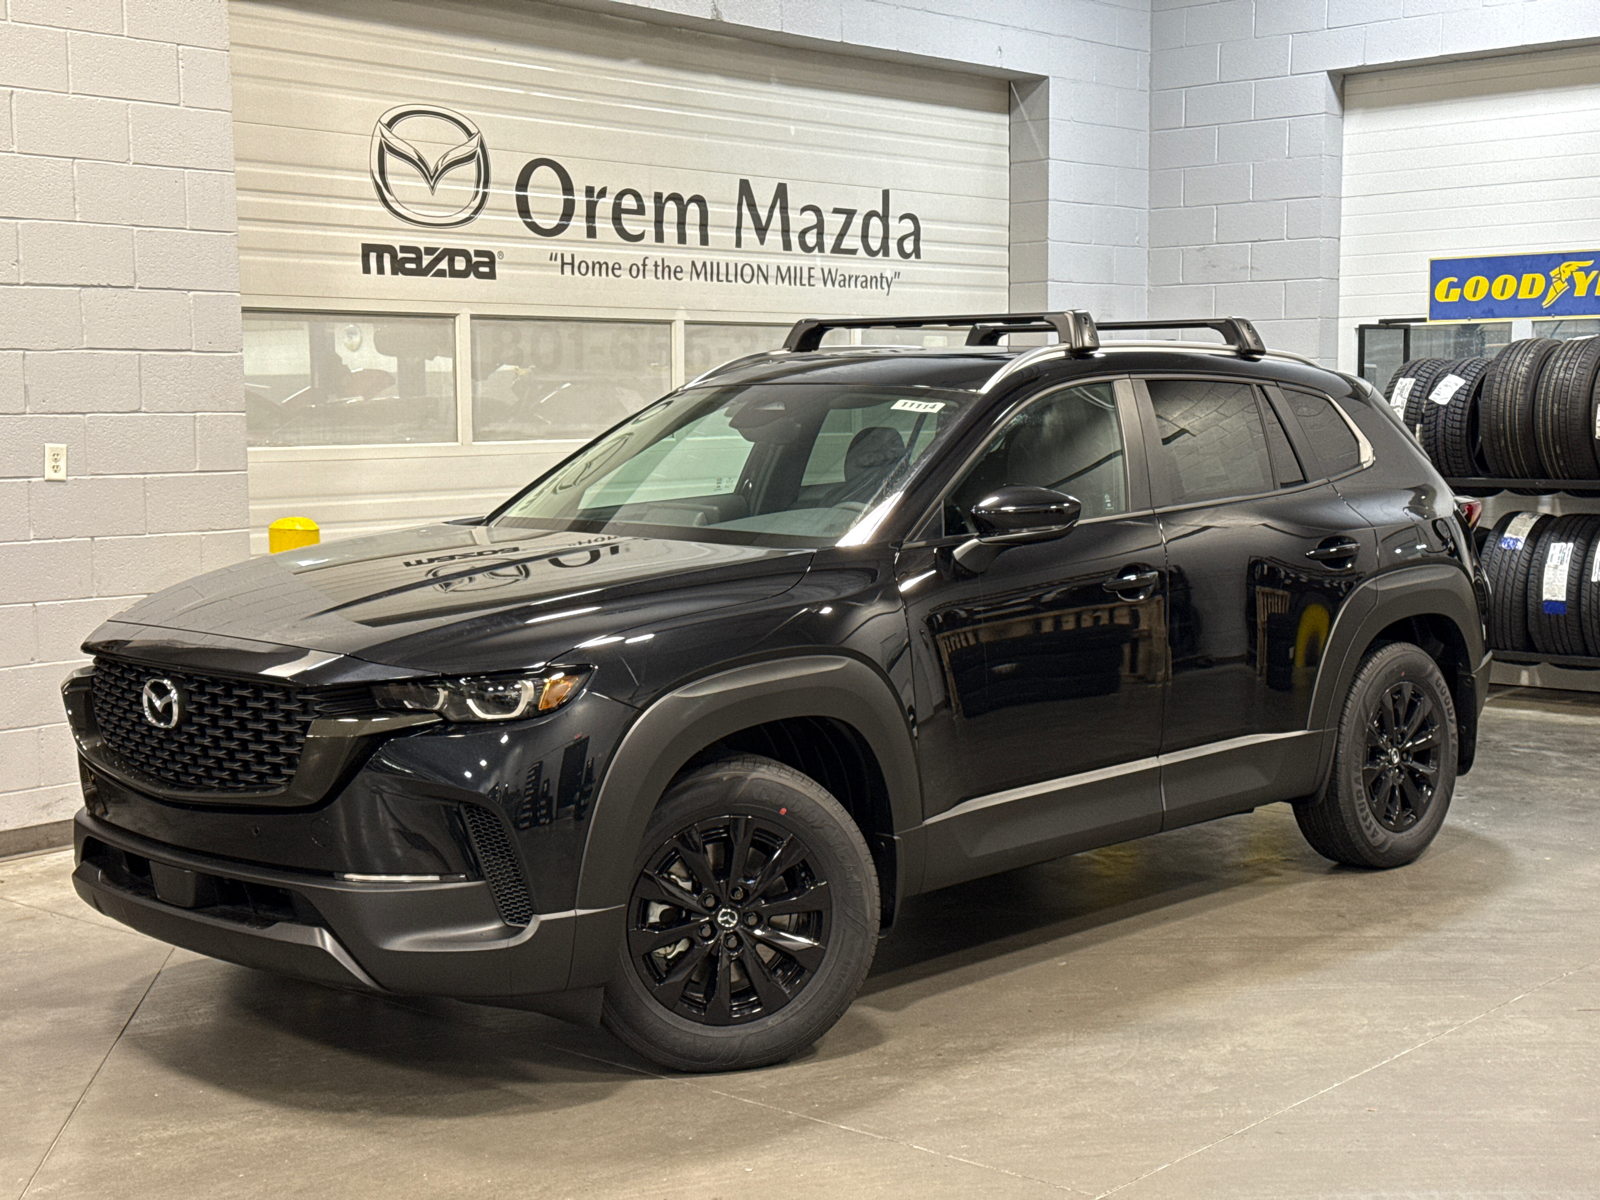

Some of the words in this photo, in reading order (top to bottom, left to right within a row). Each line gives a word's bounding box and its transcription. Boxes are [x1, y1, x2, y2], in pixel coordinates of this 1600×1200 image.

[514, 157, 710, 247] Orem
[734, 178, 922, 260] Mazda
[361, 243, 497, 281] mazda
[628, 256, 650, 280] of
[653, 258, 684, 281] the
[690, 260, 769, 285] MILLION
[775, 264, 816, 288] MILE
